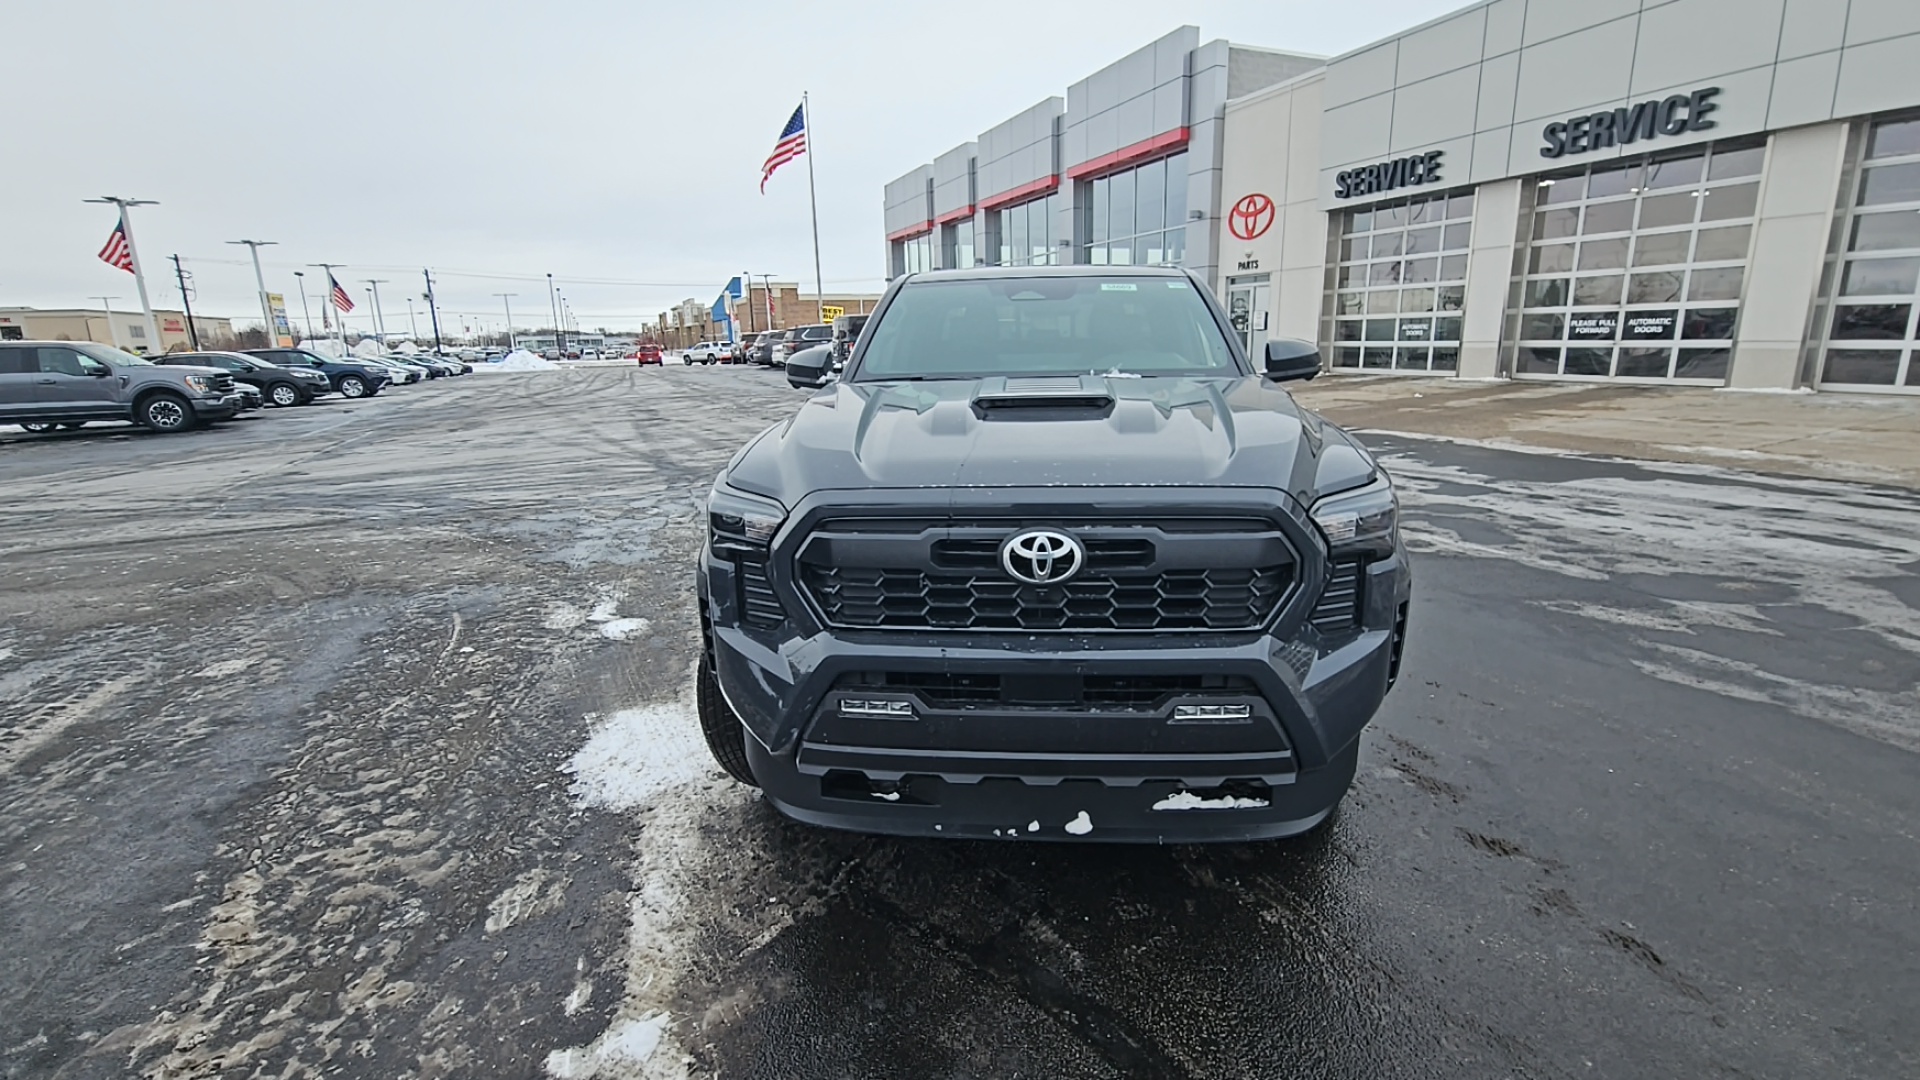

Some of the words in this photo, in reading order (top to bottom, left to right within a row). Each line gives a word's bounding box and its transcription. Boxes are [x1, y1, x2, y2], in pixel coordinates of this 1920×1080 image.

[1540, 87, 1720, 158] SERVICE
[1334, 150, 1445, 199] SERVICE
[1237, 260, 1259, 271] PARTS
[1570, 319, 1597, 327] PLEASE
[1598, 319, 1616, 327] PULL
[1628, 318, 1672, 326] AUTOMATIC
[1575, 326, 1610, 334] FORWARD
